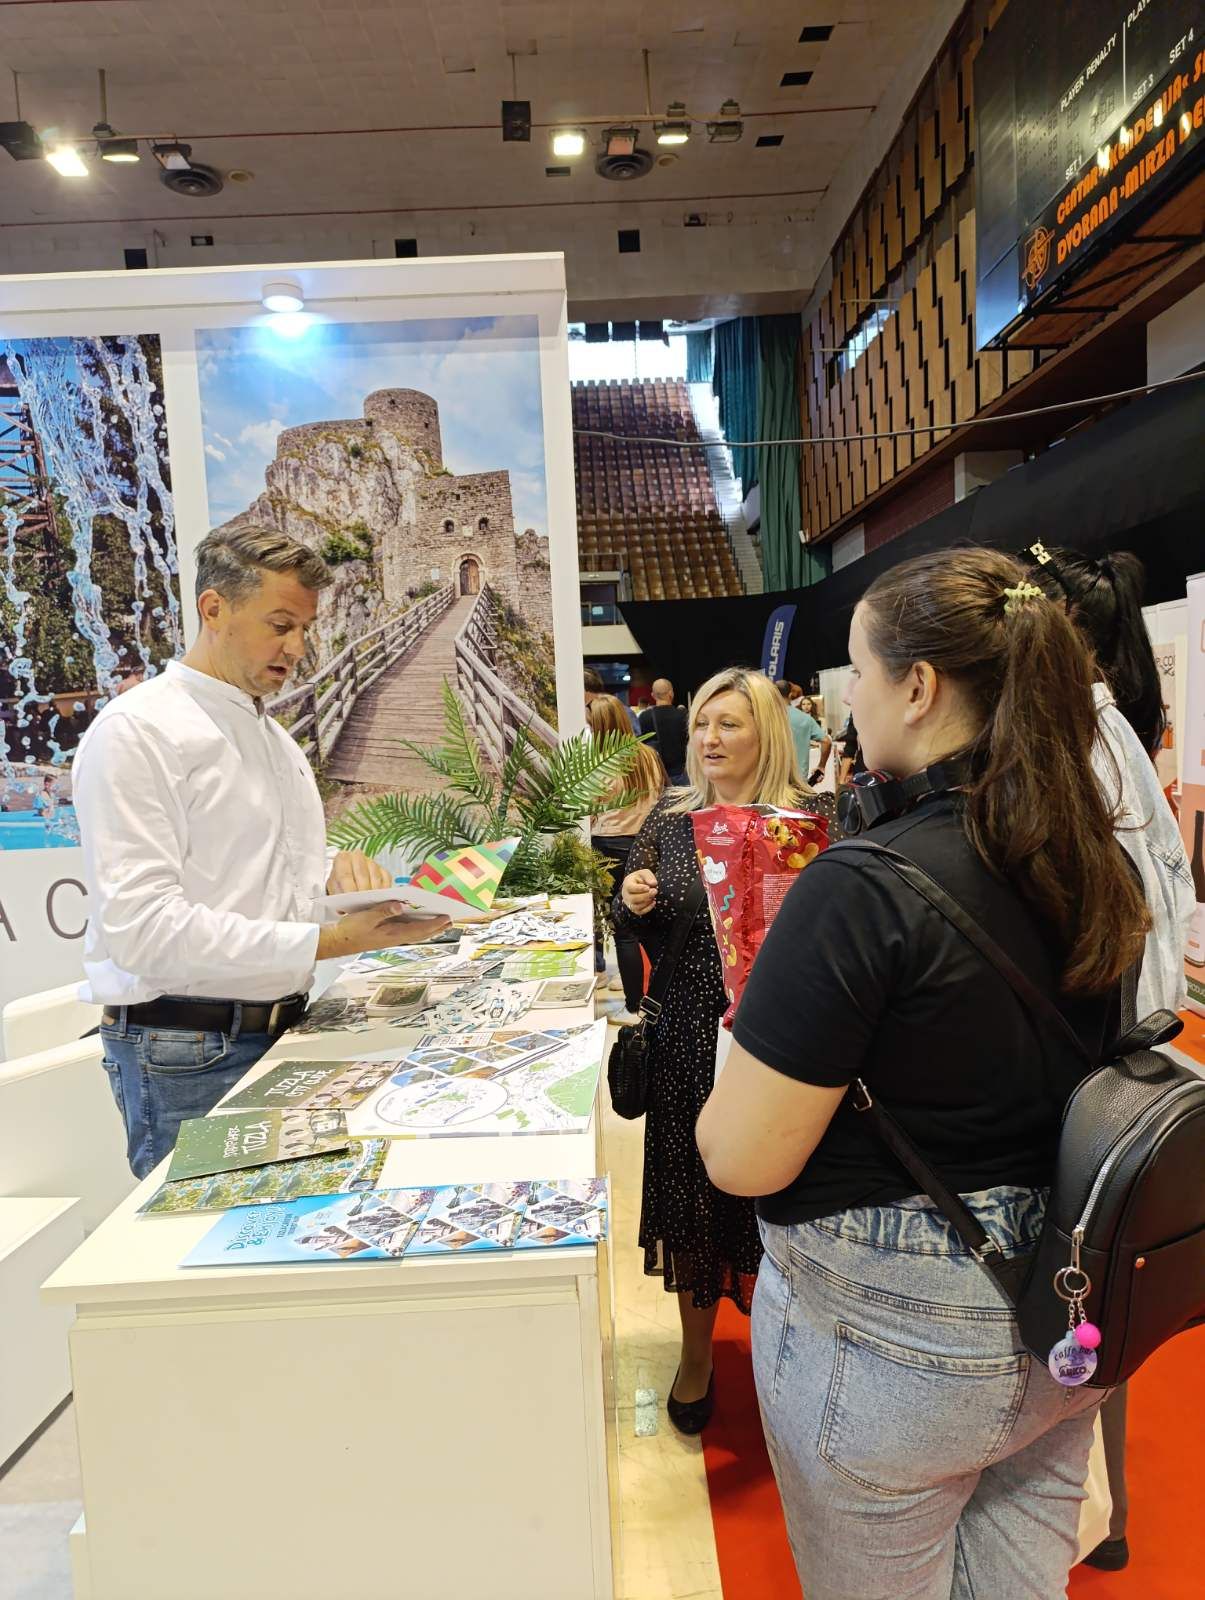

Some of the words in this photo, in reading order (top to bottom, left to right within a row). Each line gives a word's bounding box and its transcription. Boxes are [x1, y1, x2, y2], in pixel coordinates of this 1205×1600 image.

[1127, 0, 1150, 28] PLAY
[1169, 35, 1186, 64] SET
[1188, 27, 1194, 42] 4
[1060, 76, 1084, 112] PLAYER
[1086, 33, 1117, 80] PENALTY
[1132, 80, 1147, 104] SET
[1065, 159, 1078, 181] SET
[1057, 166, 1097, 225] CENTAR
[1058, 187, 1118, 265] DVORANA
[769, 620, 784, 681] OLARIS
[264, 1069, 316, 1097] TUZLA
[241, 1120, 272, 1154] TUZLA
